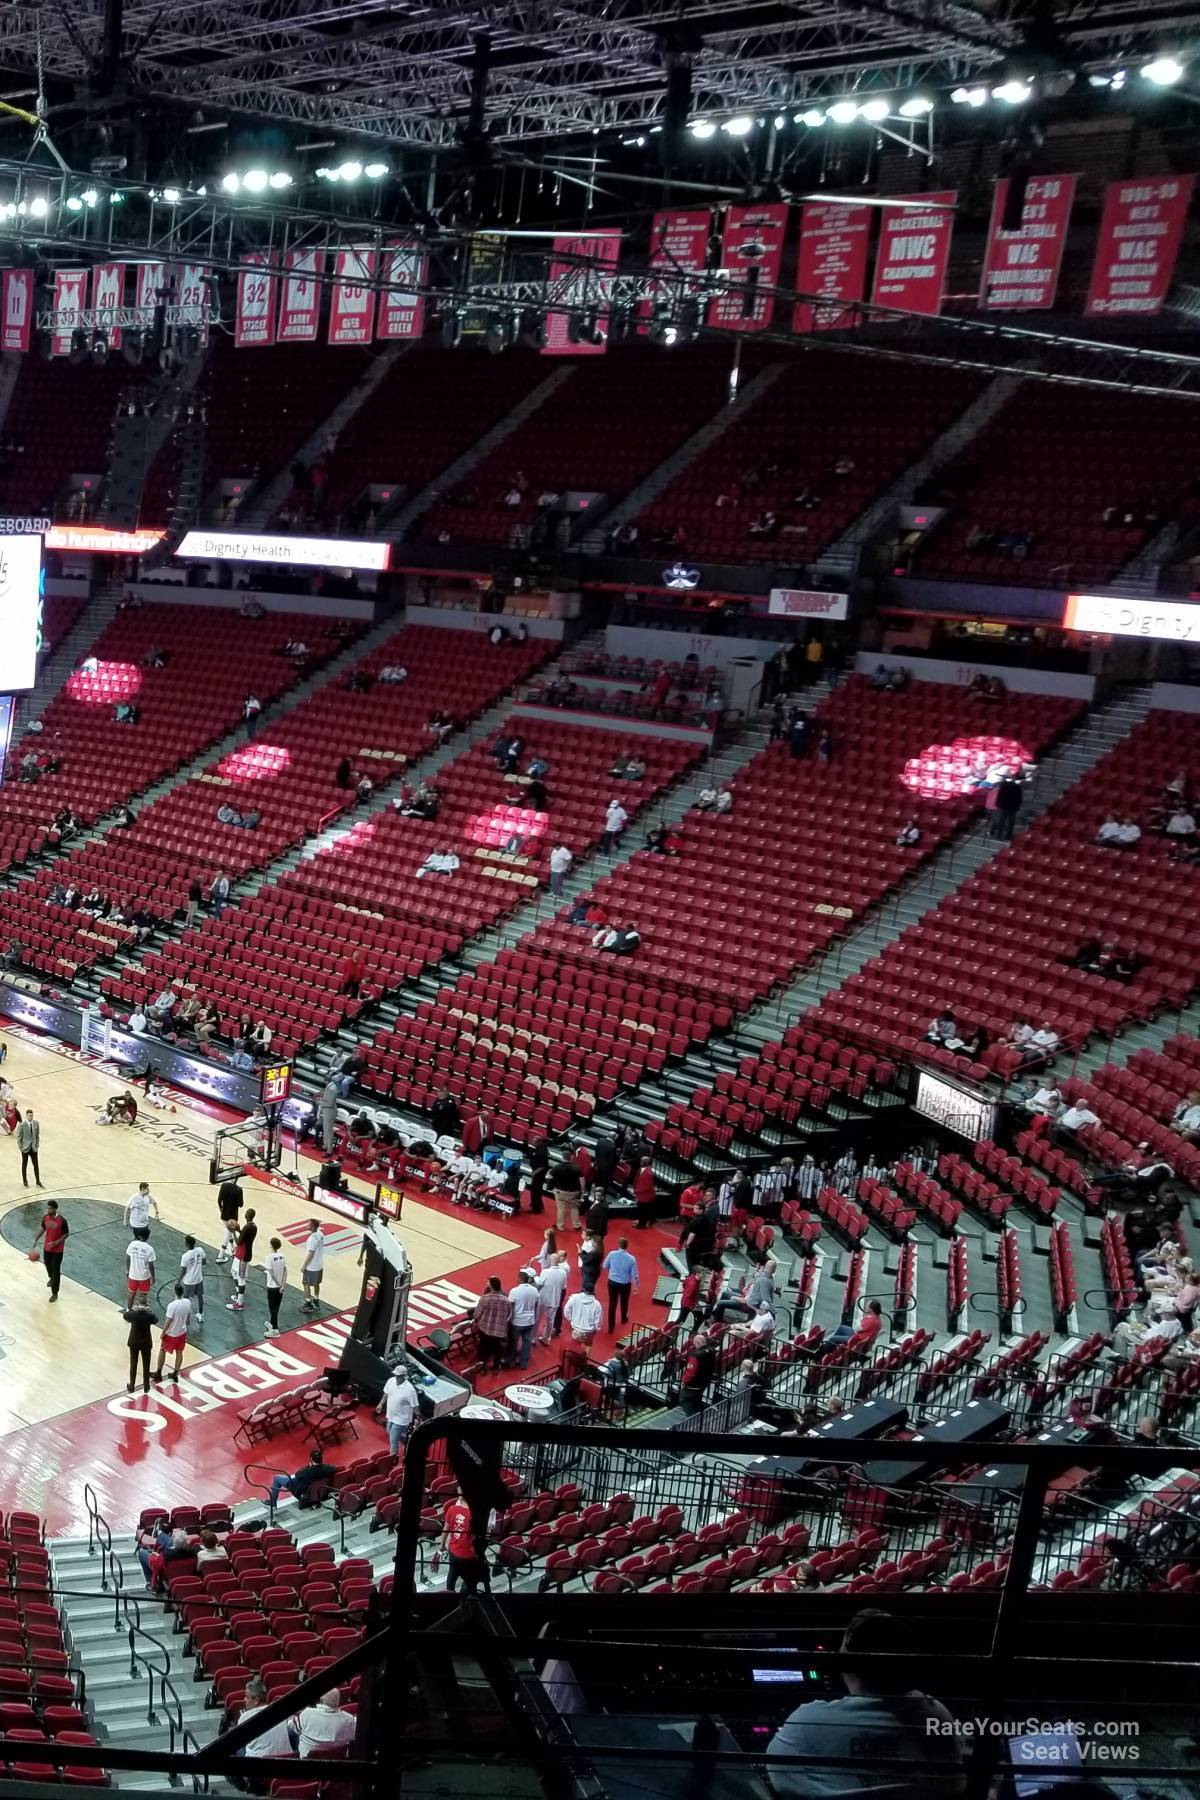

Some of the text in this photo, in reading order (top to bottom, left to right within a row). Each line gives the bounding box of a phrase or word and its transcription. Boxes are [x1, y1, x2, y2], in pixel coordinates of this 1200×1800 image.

[1022, 204, 1047, 219] EN'S
[889, 234, 937, 261] MWC
[1007, 244, 1041, 264] WAC
[1119, 240, 1158, 260] WAC
[12, 297, 21, 314] 11
[205, 540, 286, 558] Dignity Health
[137, 1079, 205, 1108] CNTER
[265, 1078, 286, 1099] 30
